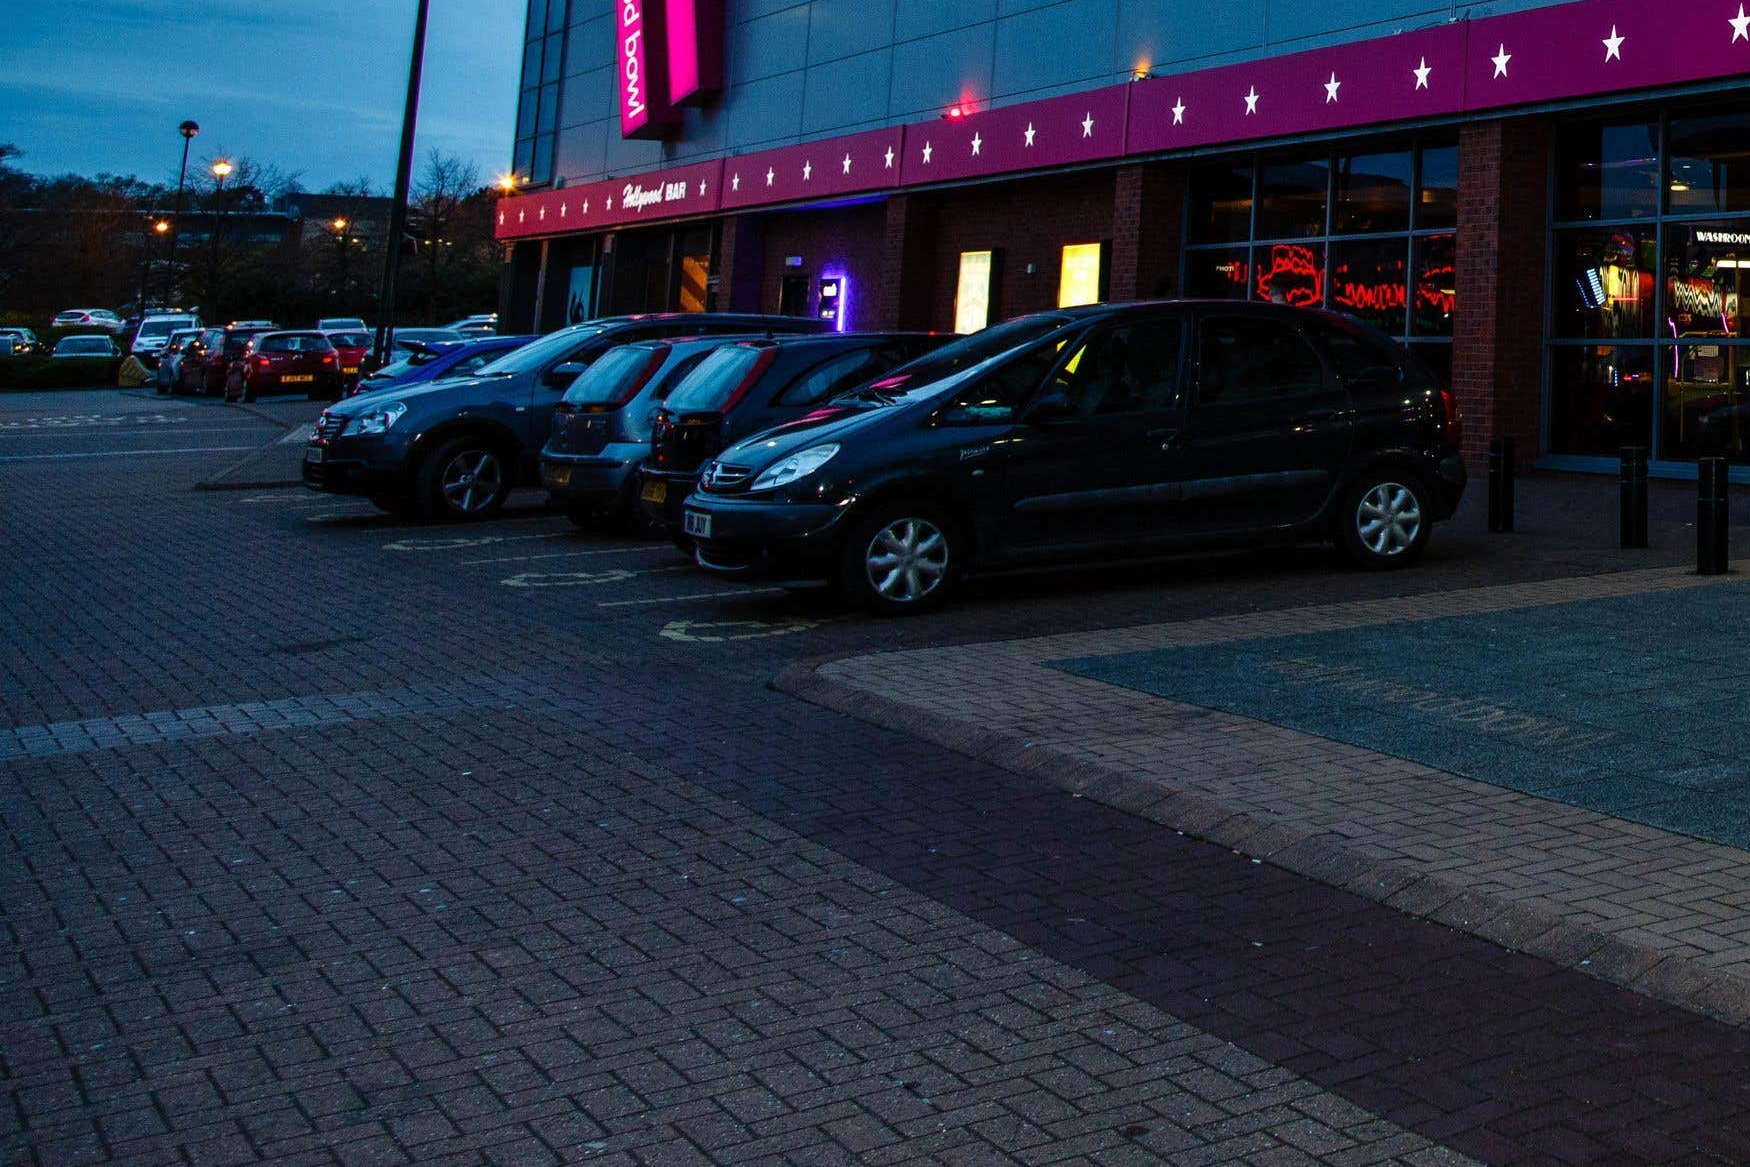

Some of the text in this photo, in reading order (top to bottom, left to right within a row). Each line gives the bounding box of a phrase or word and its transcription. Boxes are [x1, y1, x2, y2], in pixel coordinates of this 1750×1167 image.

[624, 29, 646, 119] bowl
[622, 180, 687, 213] Hollywood BAR
